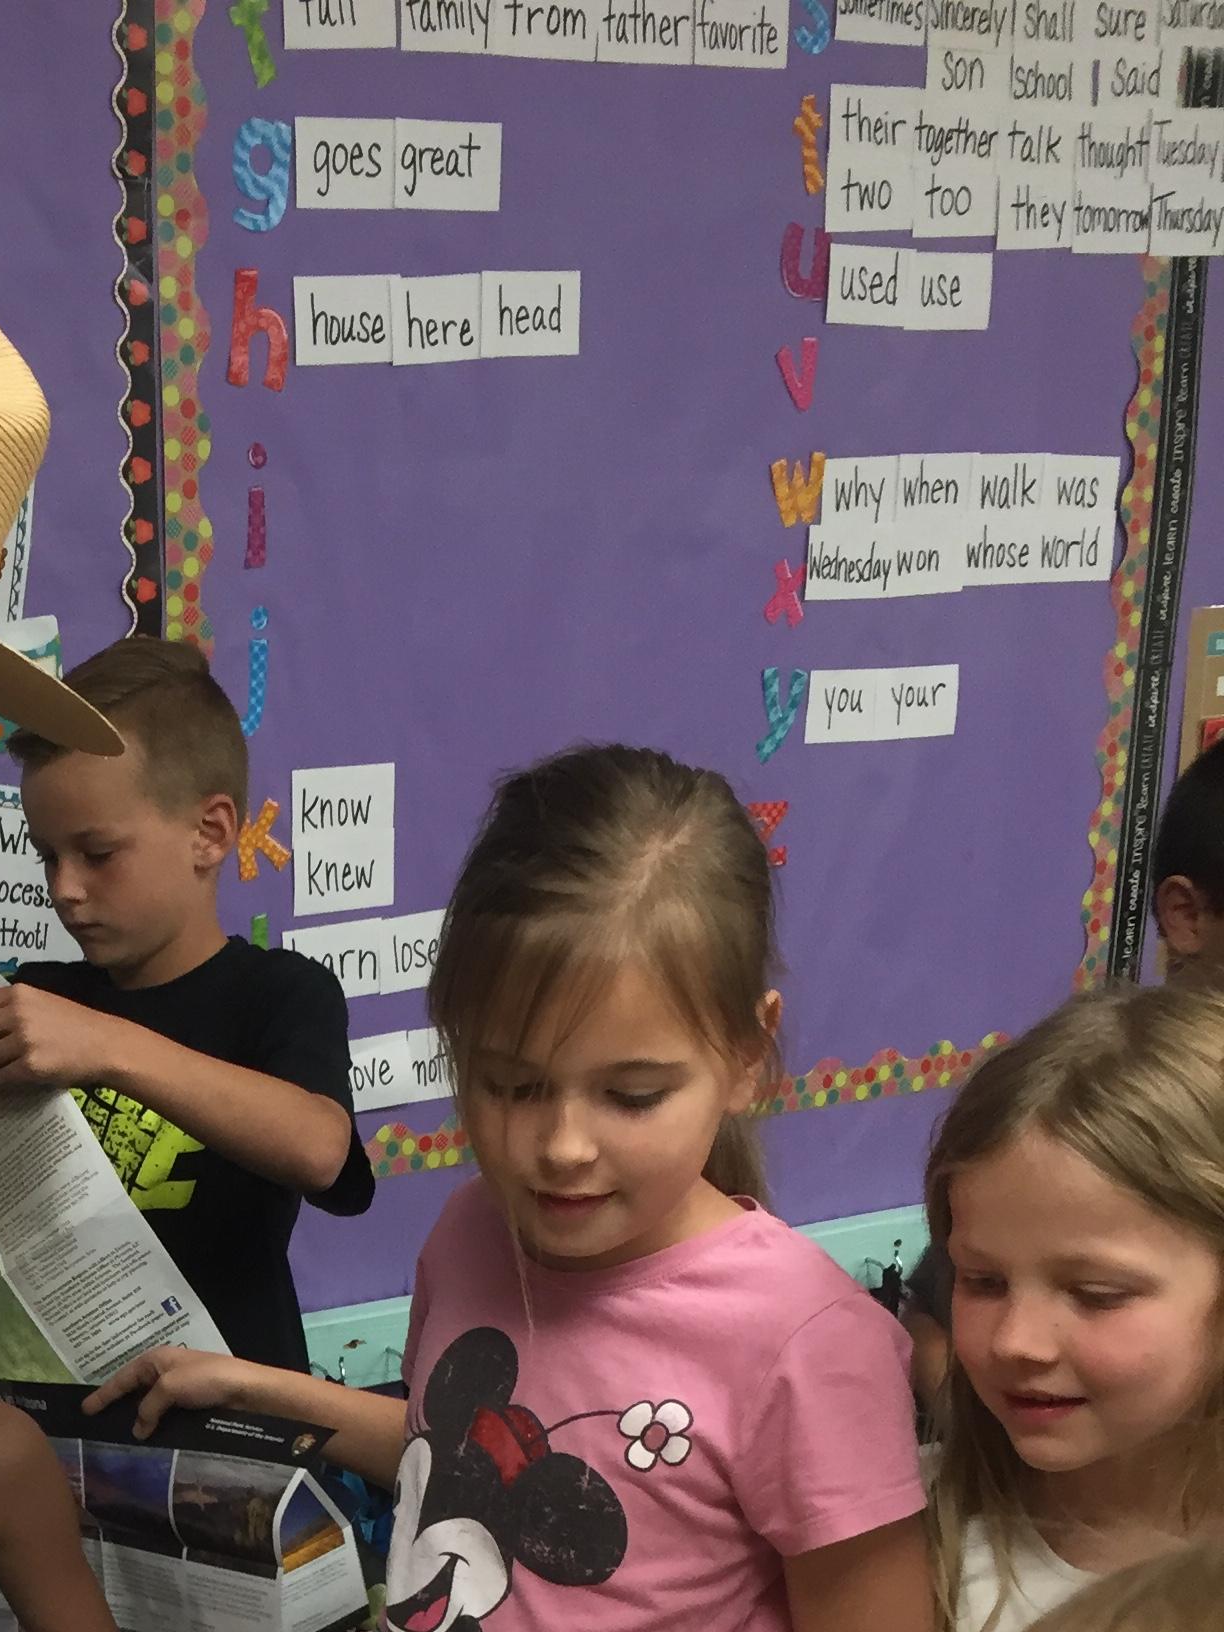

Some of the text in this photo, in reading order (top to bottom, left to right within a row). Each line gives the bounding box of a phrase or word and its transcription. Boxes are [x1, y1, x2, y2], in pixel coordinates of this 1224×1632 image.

[601, 0, 690, 48] father
[695, 0, 781, 56] favorite
[312, 131, 482, 197] goes great
[842, 97, 1220, 179] their together talk thought Tuesday
[842, 169, 1224, 248] two too they tomorrow Thursday
[840, 250, 964, 308] used use
[310, 284, 564, 350] house here head
[833, 459, 1100, 525] why when walk was
[808, 541, 893, 592] Wednesday
[896, 546, 941, 573] won
[966, 523, 1030, 570] whose
[824, 682, 947, 730] you your
[301, 788, 373, 832] know
[306, 850, 375, 894] knew
[0, 917, 49, 951] Hoot!
[292, 935, 439, 981] arn lose
[348, 1057, 394, 1092] ove
